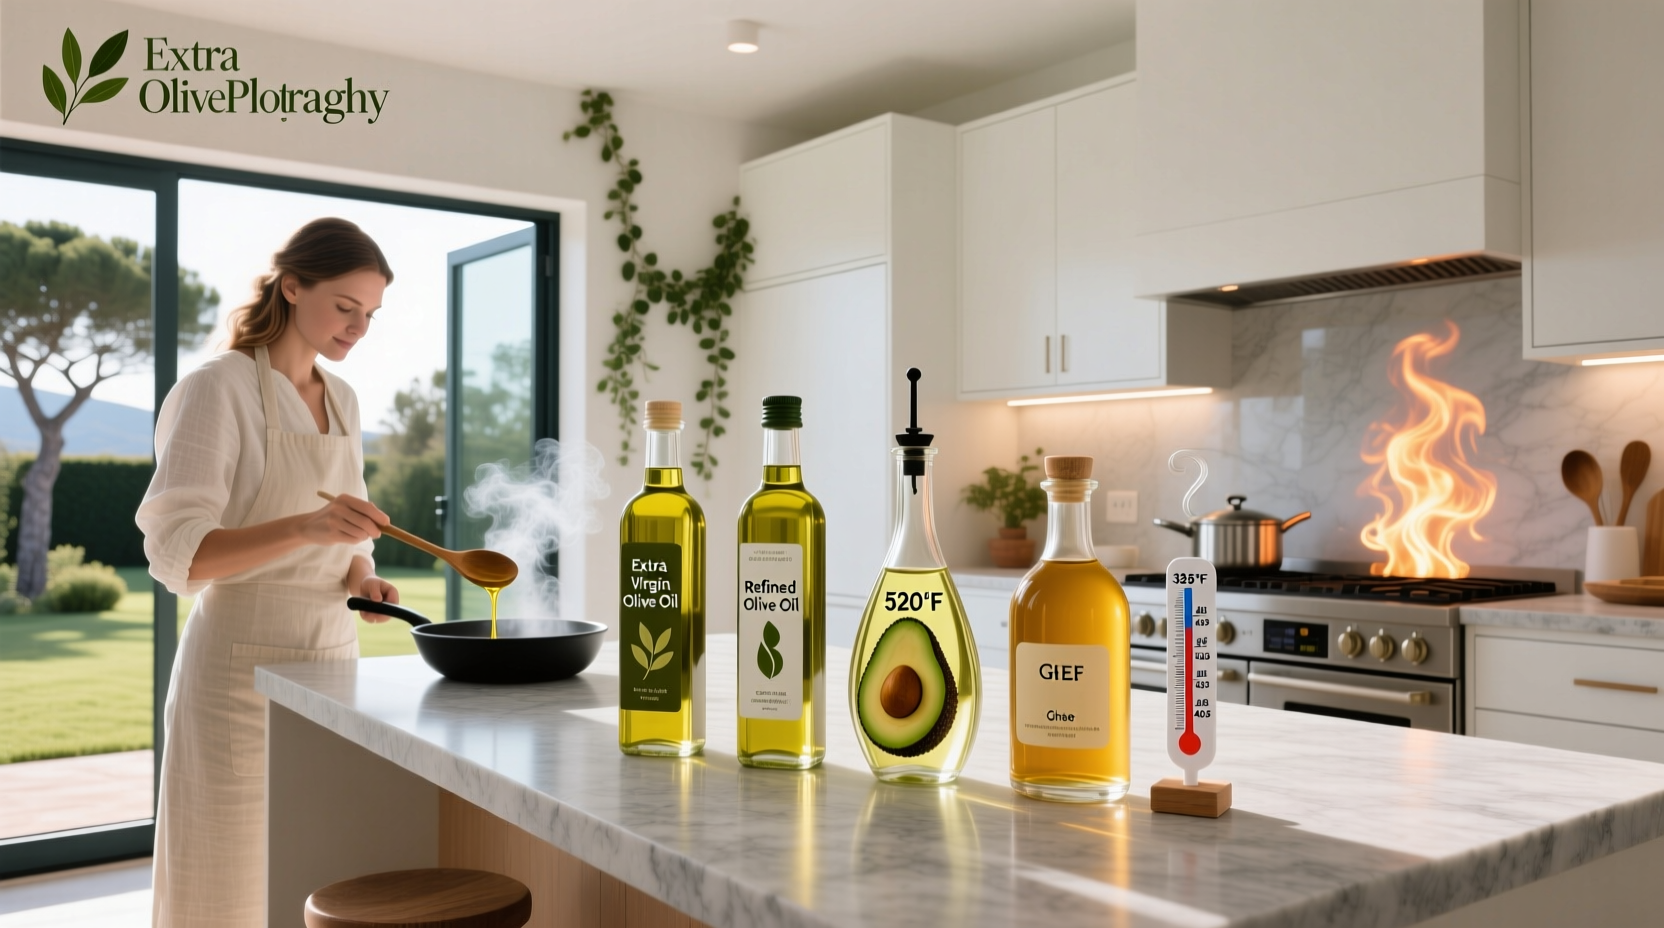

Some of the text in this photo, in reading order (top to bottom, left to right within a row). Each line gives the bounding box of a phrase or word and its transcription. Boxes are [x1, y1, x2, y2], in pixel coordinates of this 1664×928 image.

[632, 559, 667, 573] Extra
[631, 576, 671, 593] Virgin
[744, 579, 796, 594] Refined
[623, 594, 678, 609] Olive Oil
[743, 596, 799, 612] Olive Oil
